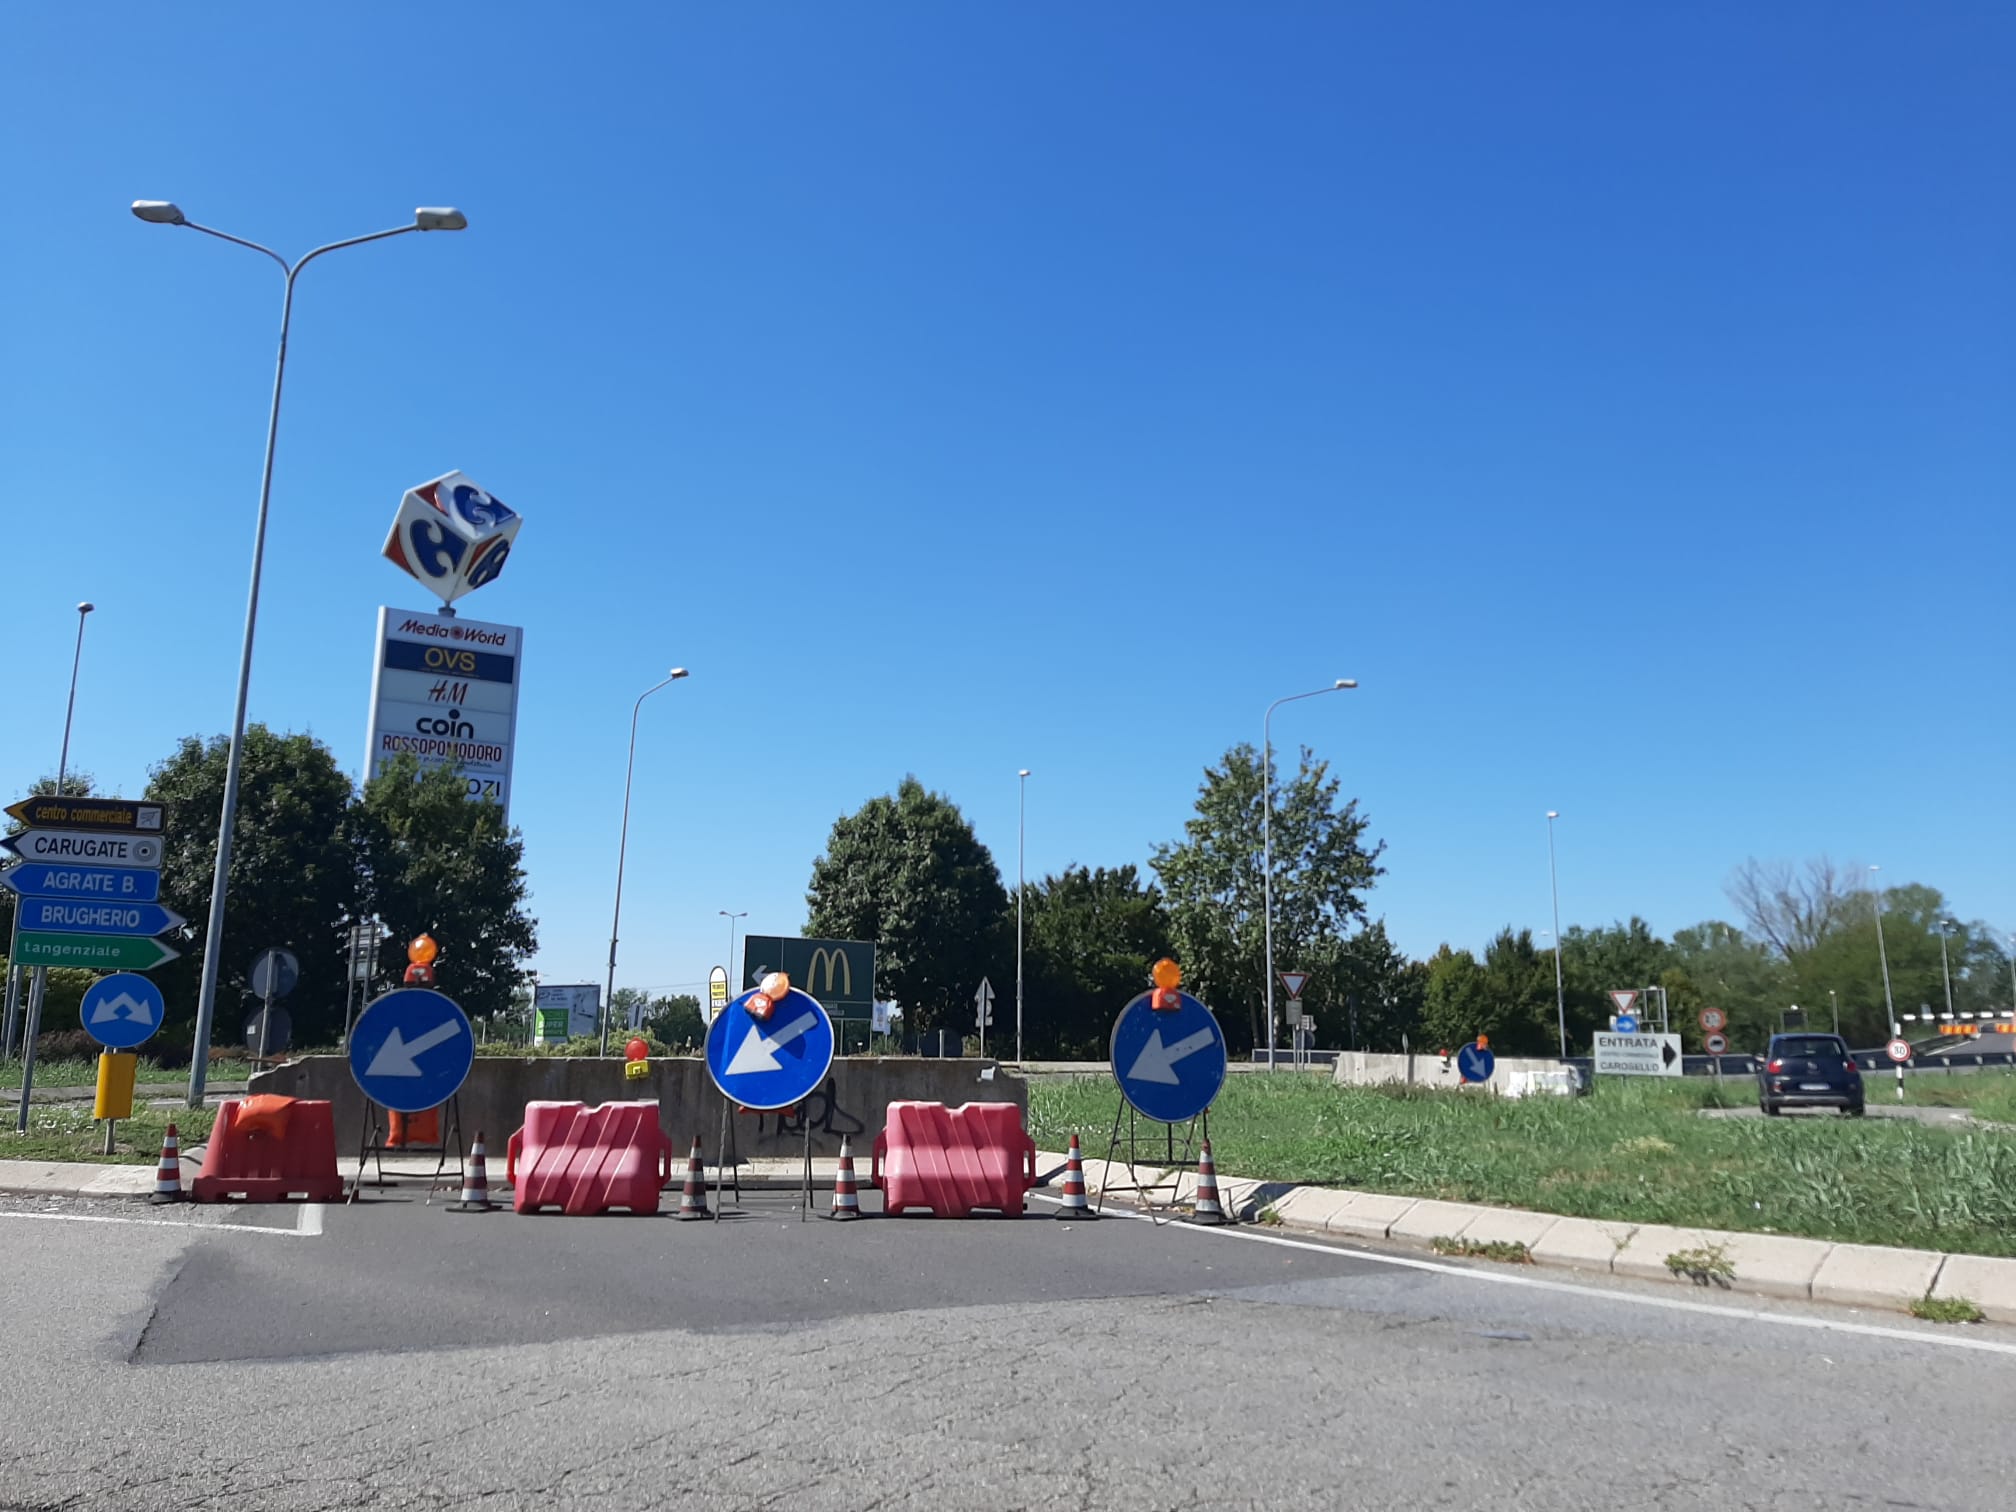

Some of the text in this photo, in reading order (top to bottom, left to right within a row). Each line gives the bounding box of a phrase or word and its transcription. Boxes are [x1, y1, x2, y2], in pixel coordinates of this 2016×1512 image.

[398, 619, 506, 647] Media World
[424, 647, 476, 672] OVS
[416, 708, 474, 739] coin
[36, 804, 133, 825] centro commerciale
[35, 837, 128, 858] CARUGATE
[43, 872, 138, 893] AGRATE B.
[41, 906, 141, 928] BRUGHERIO
[24, 941, 121, 957] tangenziale
[1600, 1037, 1658, 1048] ENTRATA
